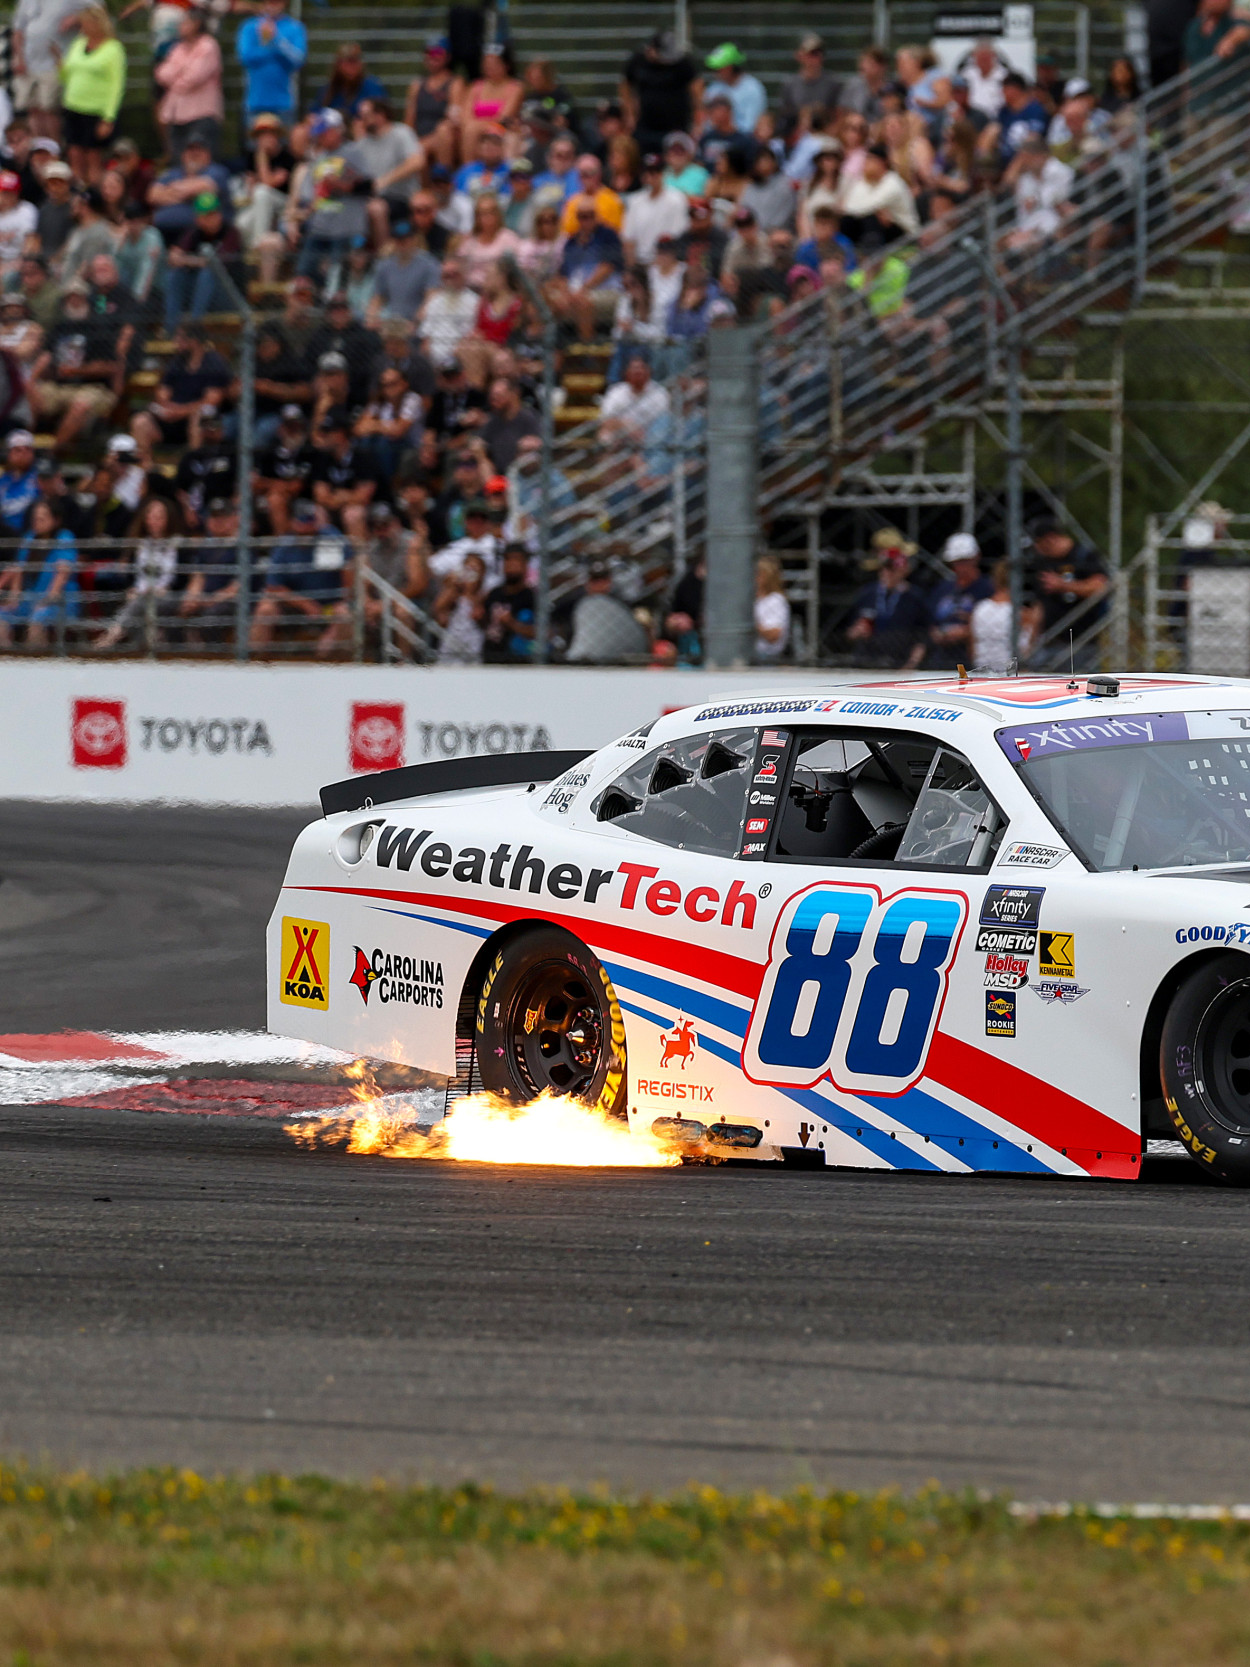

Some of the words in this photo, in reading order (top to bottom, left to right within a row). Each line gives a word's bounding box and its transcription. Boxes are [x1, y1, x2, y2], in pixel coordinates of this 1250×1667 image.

[905, 704, 963, 722] ZILISCH
[139, 716, 274, 755] TOYOTA
[417, 718, 555, 757] TOYOTA
[1030, 719, 1154, 749] xfinity
[556, 769, 591, 787] Blues
[543, 787, 575, 813] Hog
[748, 820, 765, 831] SEM
[1007, 855, 1031, 863] RACE
[1031, 857, 1051, 865] CAR
[1022, 845, 1059, 858] NASCAR
[990, 896, 1032, 919] xfinity
[1000, 914, 1018, 923] SERIES
[979, 932, 1036, 951] COMETIC
[371, 948, 445, 986] CAROLINA
[985, 953, 1029, 978] Holley
[1040, 967, 1074, 977] KENNAMETAL
[284, 981, 325, 1001] KOA
[758, 889, 962, 1078] 88
[984, 973, 1021, 988] MSD
[378, 978, 444, 1009] CARPORTS
[476, 950, 505, 1034] EAGLE
[988, 1002, 1014, 1011] SUNOCO
[987, 1019, 1014, 1029] ROOKIE
[637, 1079, 715, 1103] REGISTIX
[1165, 1096, 1219, 1164] EAGLE
